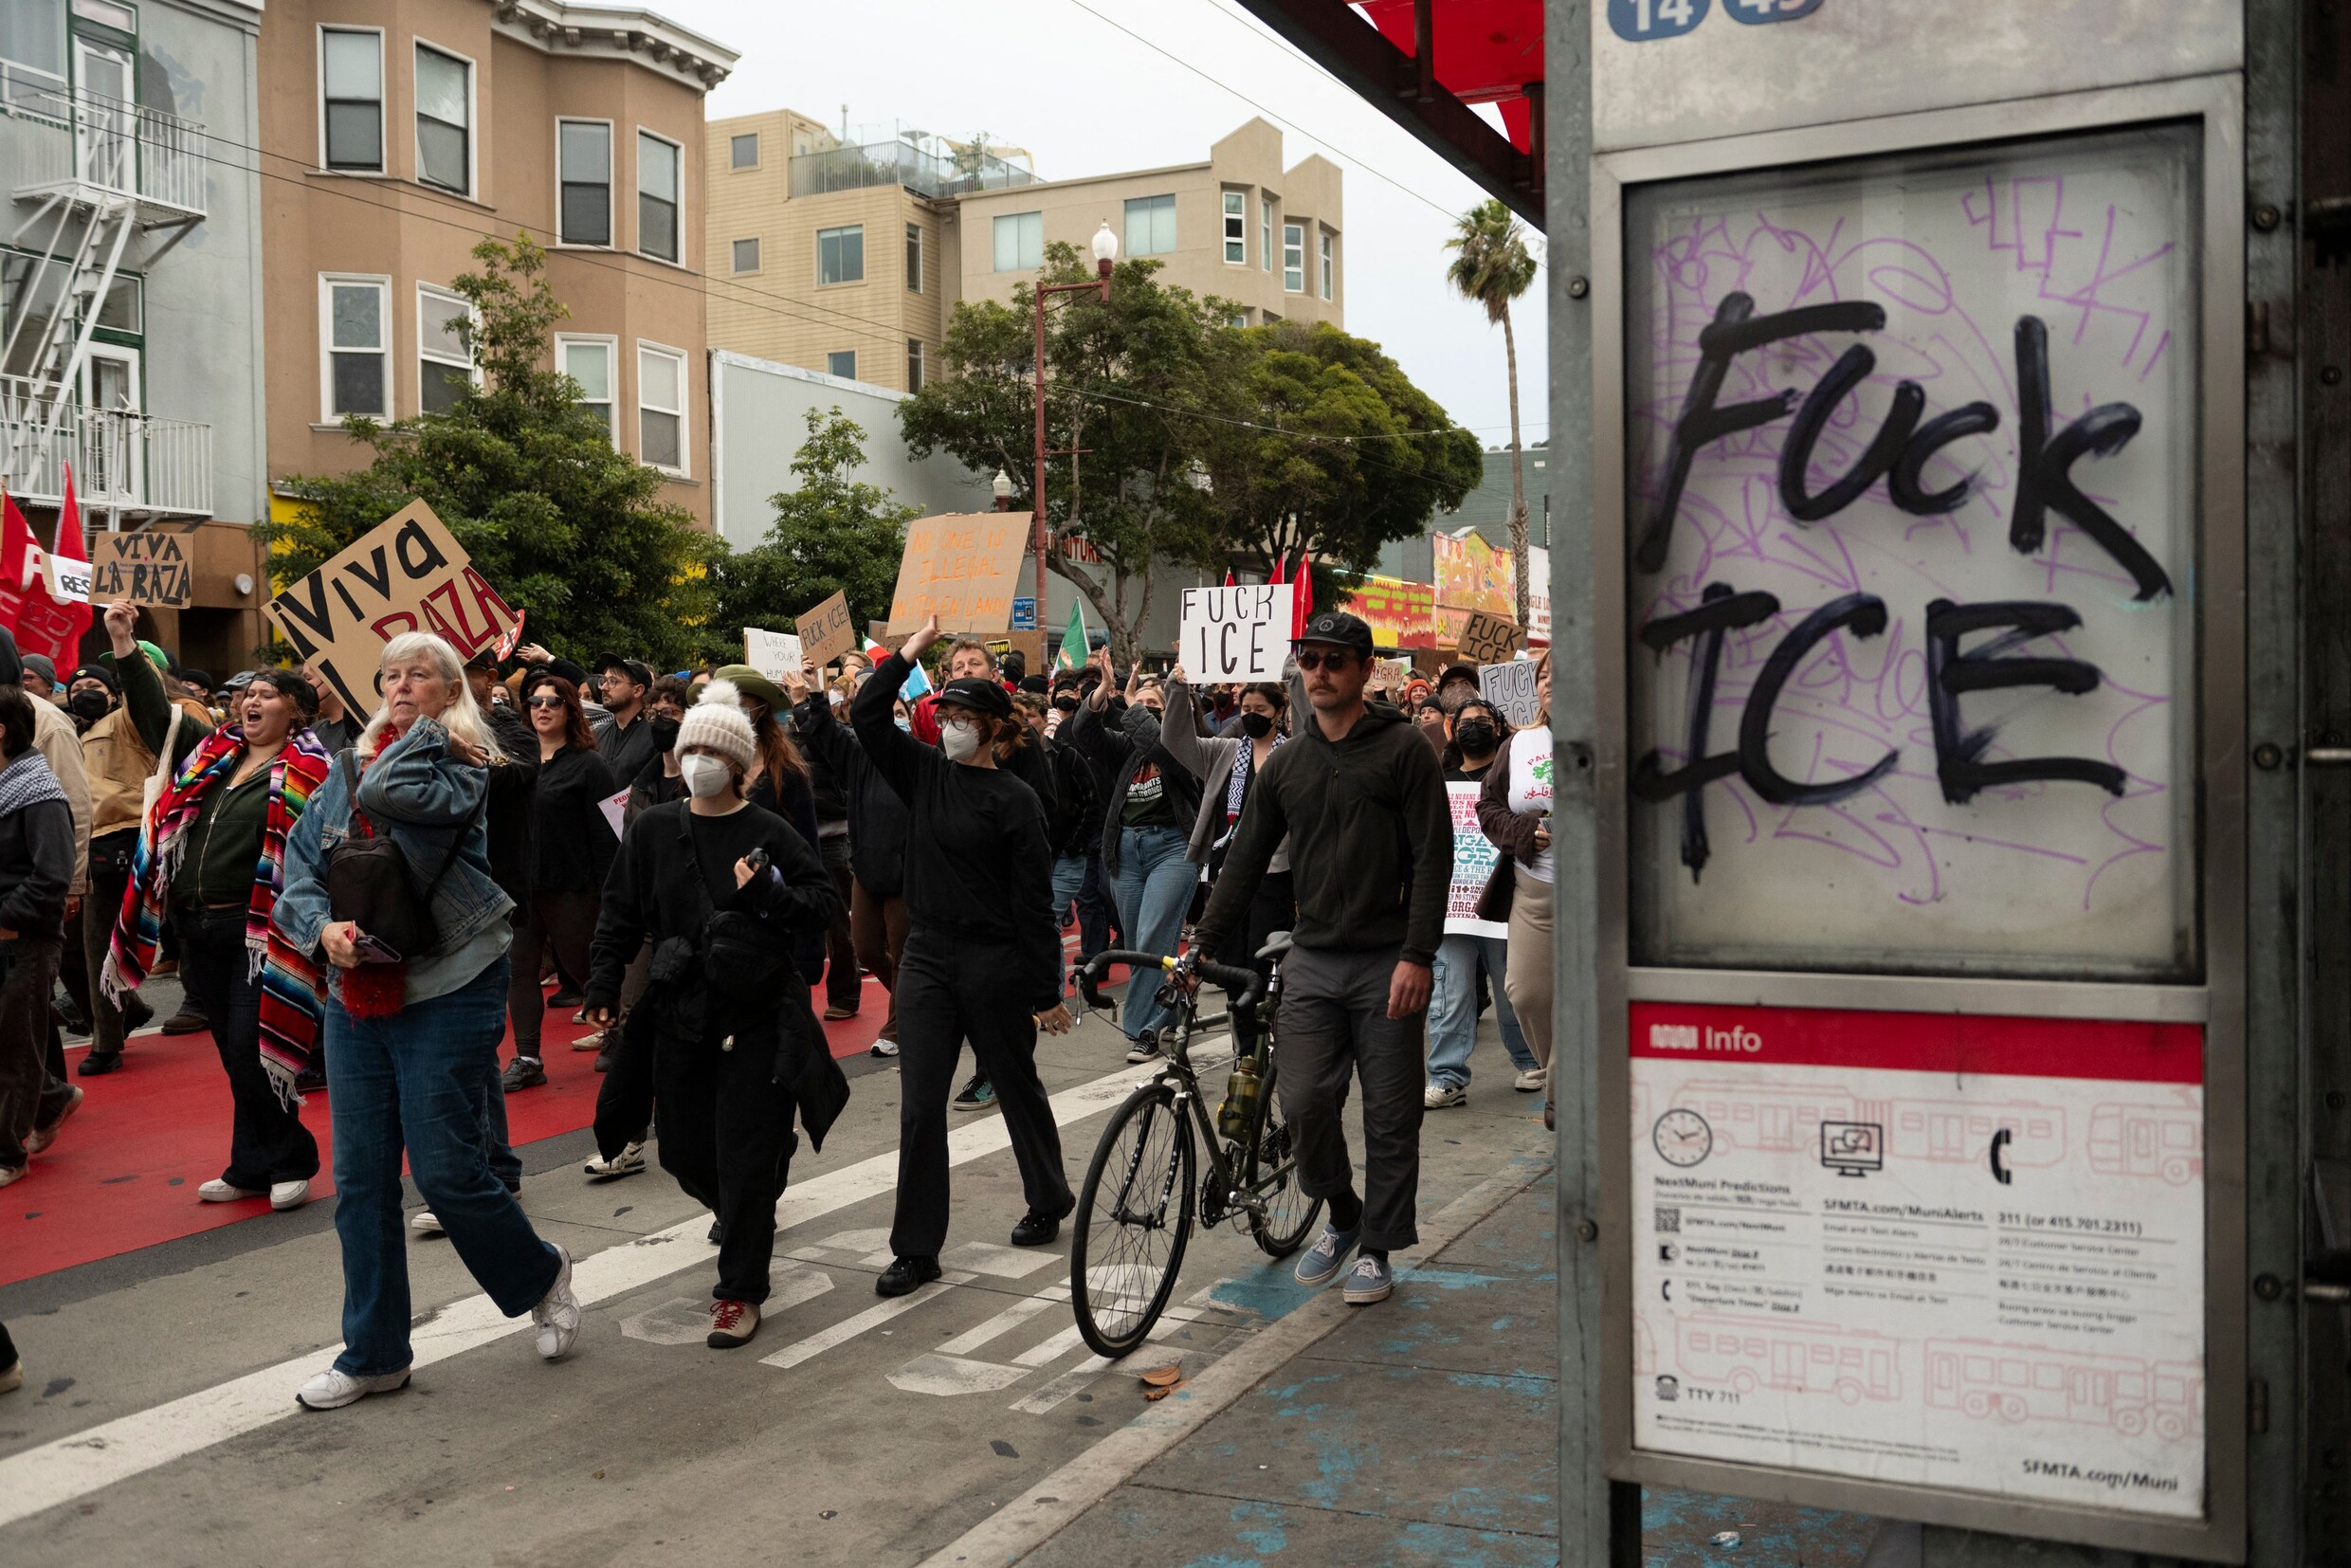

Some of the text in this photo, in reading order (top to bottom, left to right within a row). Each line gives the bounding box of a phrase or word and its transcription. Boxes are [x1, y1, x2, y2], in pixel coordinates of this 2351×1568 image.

[113, 533, 183, 562] VIVA
[940, 530, 975, 551] ONE
[95, 560, 124, 595] LA
[129, 560, 191, 606] RAZA
[919, 554, 1001, 585] ILLEGAL
[1182, 585, 1274, 623] FUCK
[801, 600, 849, 651] FUCK ICE!
[1467, 613, 1522, 652] FUCK
[763, 633, 789, 650] WHERE
[1200, 621, 1267, 675] ICE
[1463, 636, 1506, 665] ICE
[773, 650, 795, 664] YOUR
[1635, 582, 2126, 885] ICE
[1470, 866, 1486, 874] THE
[1705, 1025, 1762, 1052] Info
[1687, 1387, 1740, 1405] TTY 711
[2022, 1458, 2178, 1491] SFMTA.com/Muni
